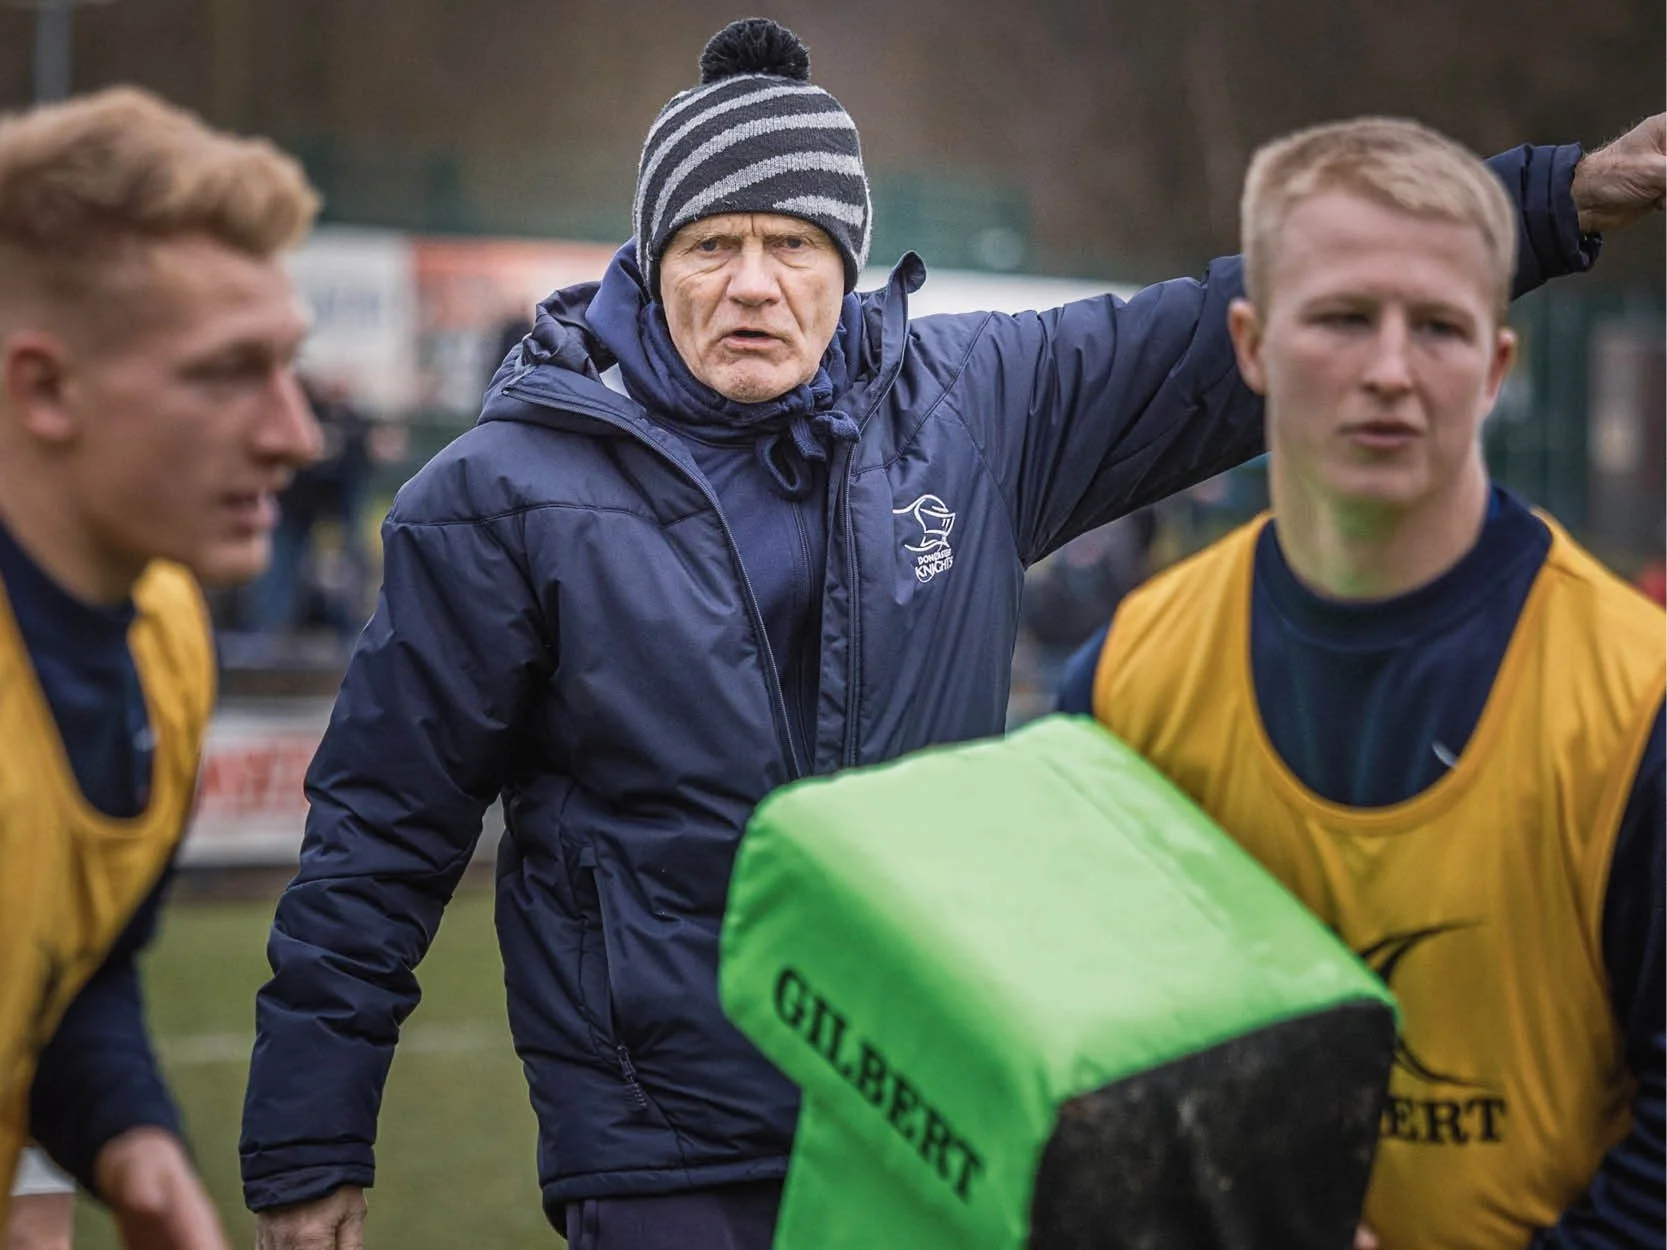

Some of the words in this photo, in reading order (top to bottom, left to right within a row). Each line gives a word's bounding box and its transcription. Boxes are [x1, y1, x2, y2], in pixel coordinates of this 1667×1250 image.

[915, 556, 954, 582] KNIGHTS
[773, 967, 986, 1203] GILBERT
[1381, 1096, 1507, 1145] ERT
